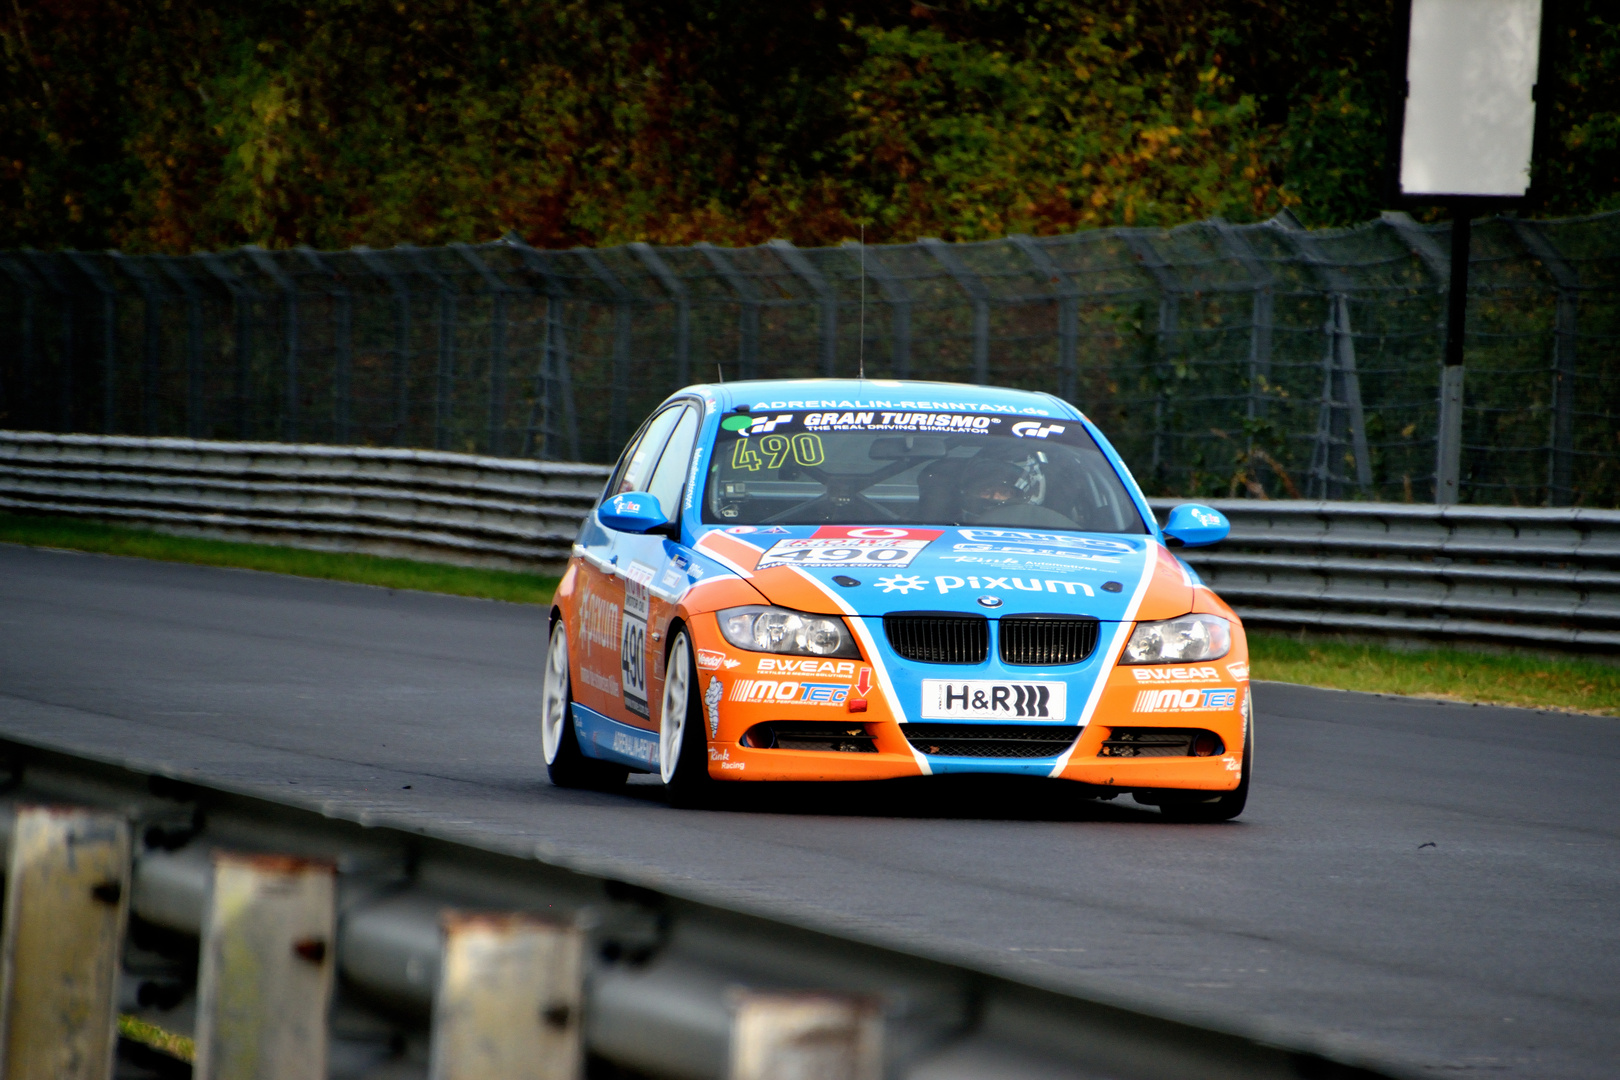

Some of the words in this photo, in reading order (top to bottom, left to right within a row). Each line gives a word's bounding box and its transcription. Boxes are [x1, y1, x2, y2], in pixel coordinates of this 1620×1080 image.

[753, 400, 1049, 416] ADRENALIN-RENNTAXI.de
[803, 412, 874, 426] GRAN
[919, 425, 989, 434] SIMULATOR
[732, 432, 825, 472] 490
[769, 547, 909, 562] 490
[934, 575, 1095, 597] pixum
[621, 620, 646, 692] 490
[757, 658, 855, 675] BWEAR
[1132, 667, 1219, 680] BWEAR
[946, 684, 1011, 712] H&R
[721, 762, 745, 770] Racing
